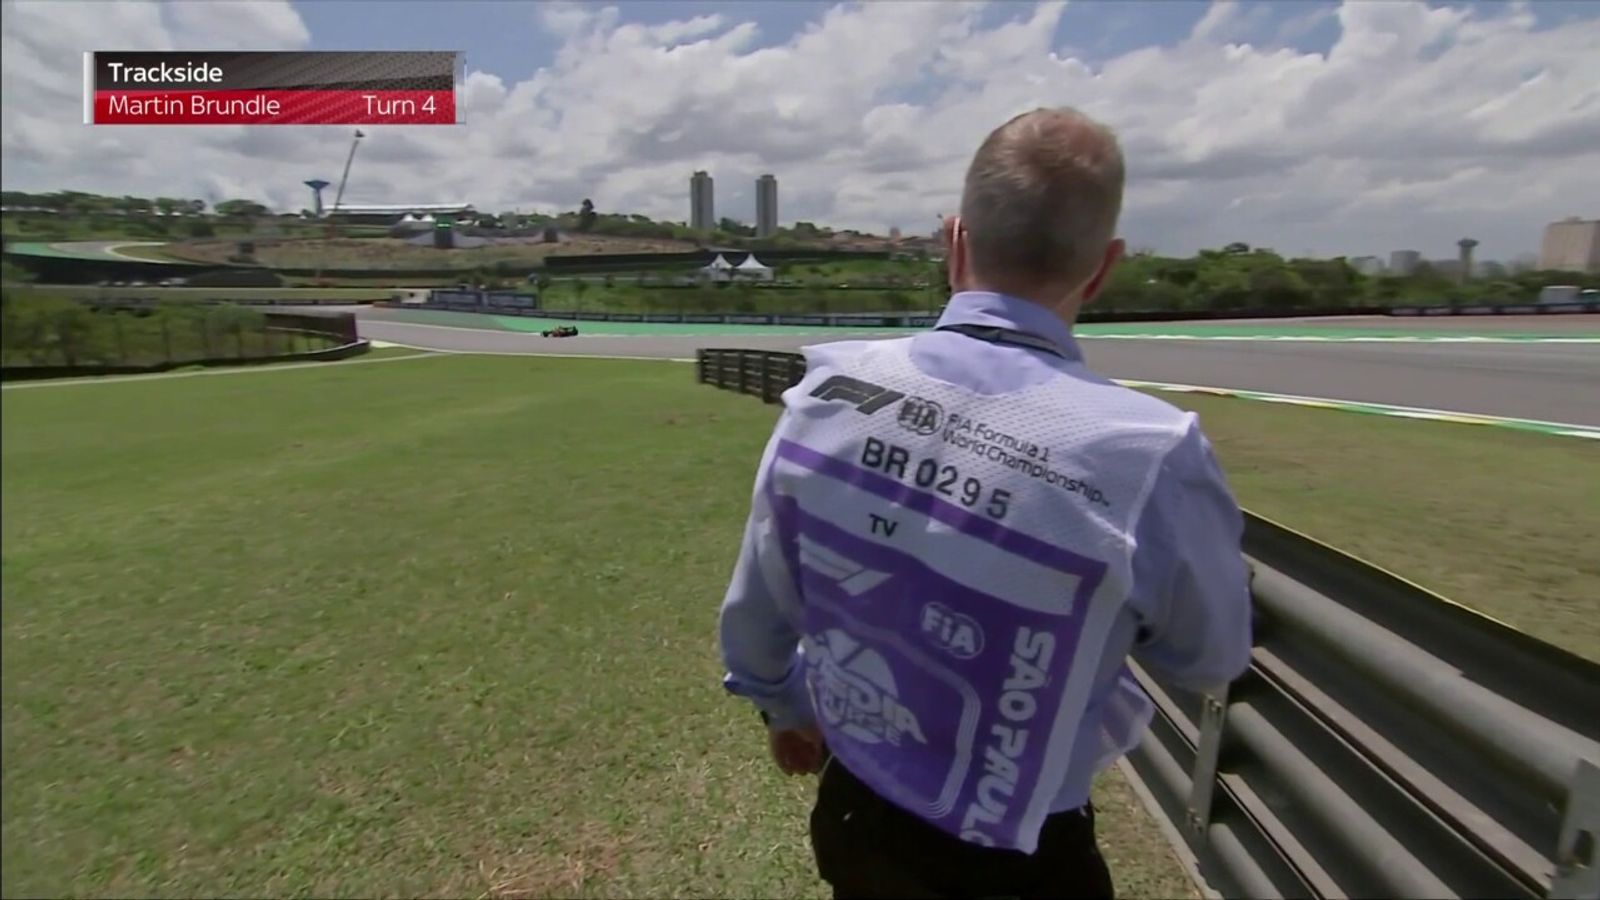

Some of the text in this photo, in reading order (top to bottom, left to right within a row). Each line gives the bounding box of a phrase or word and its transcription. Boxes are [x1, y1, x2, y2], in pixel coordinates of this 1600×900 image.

[898, 398, 940, 432] FIA
[942, 429, 986, 457] World
[948, 413, 1050, 463] FIA Formula 1
[861, 436, 910, 479] BR
[868, 513, 898, 537] TV
[921, 606, 976, 653] FIA
